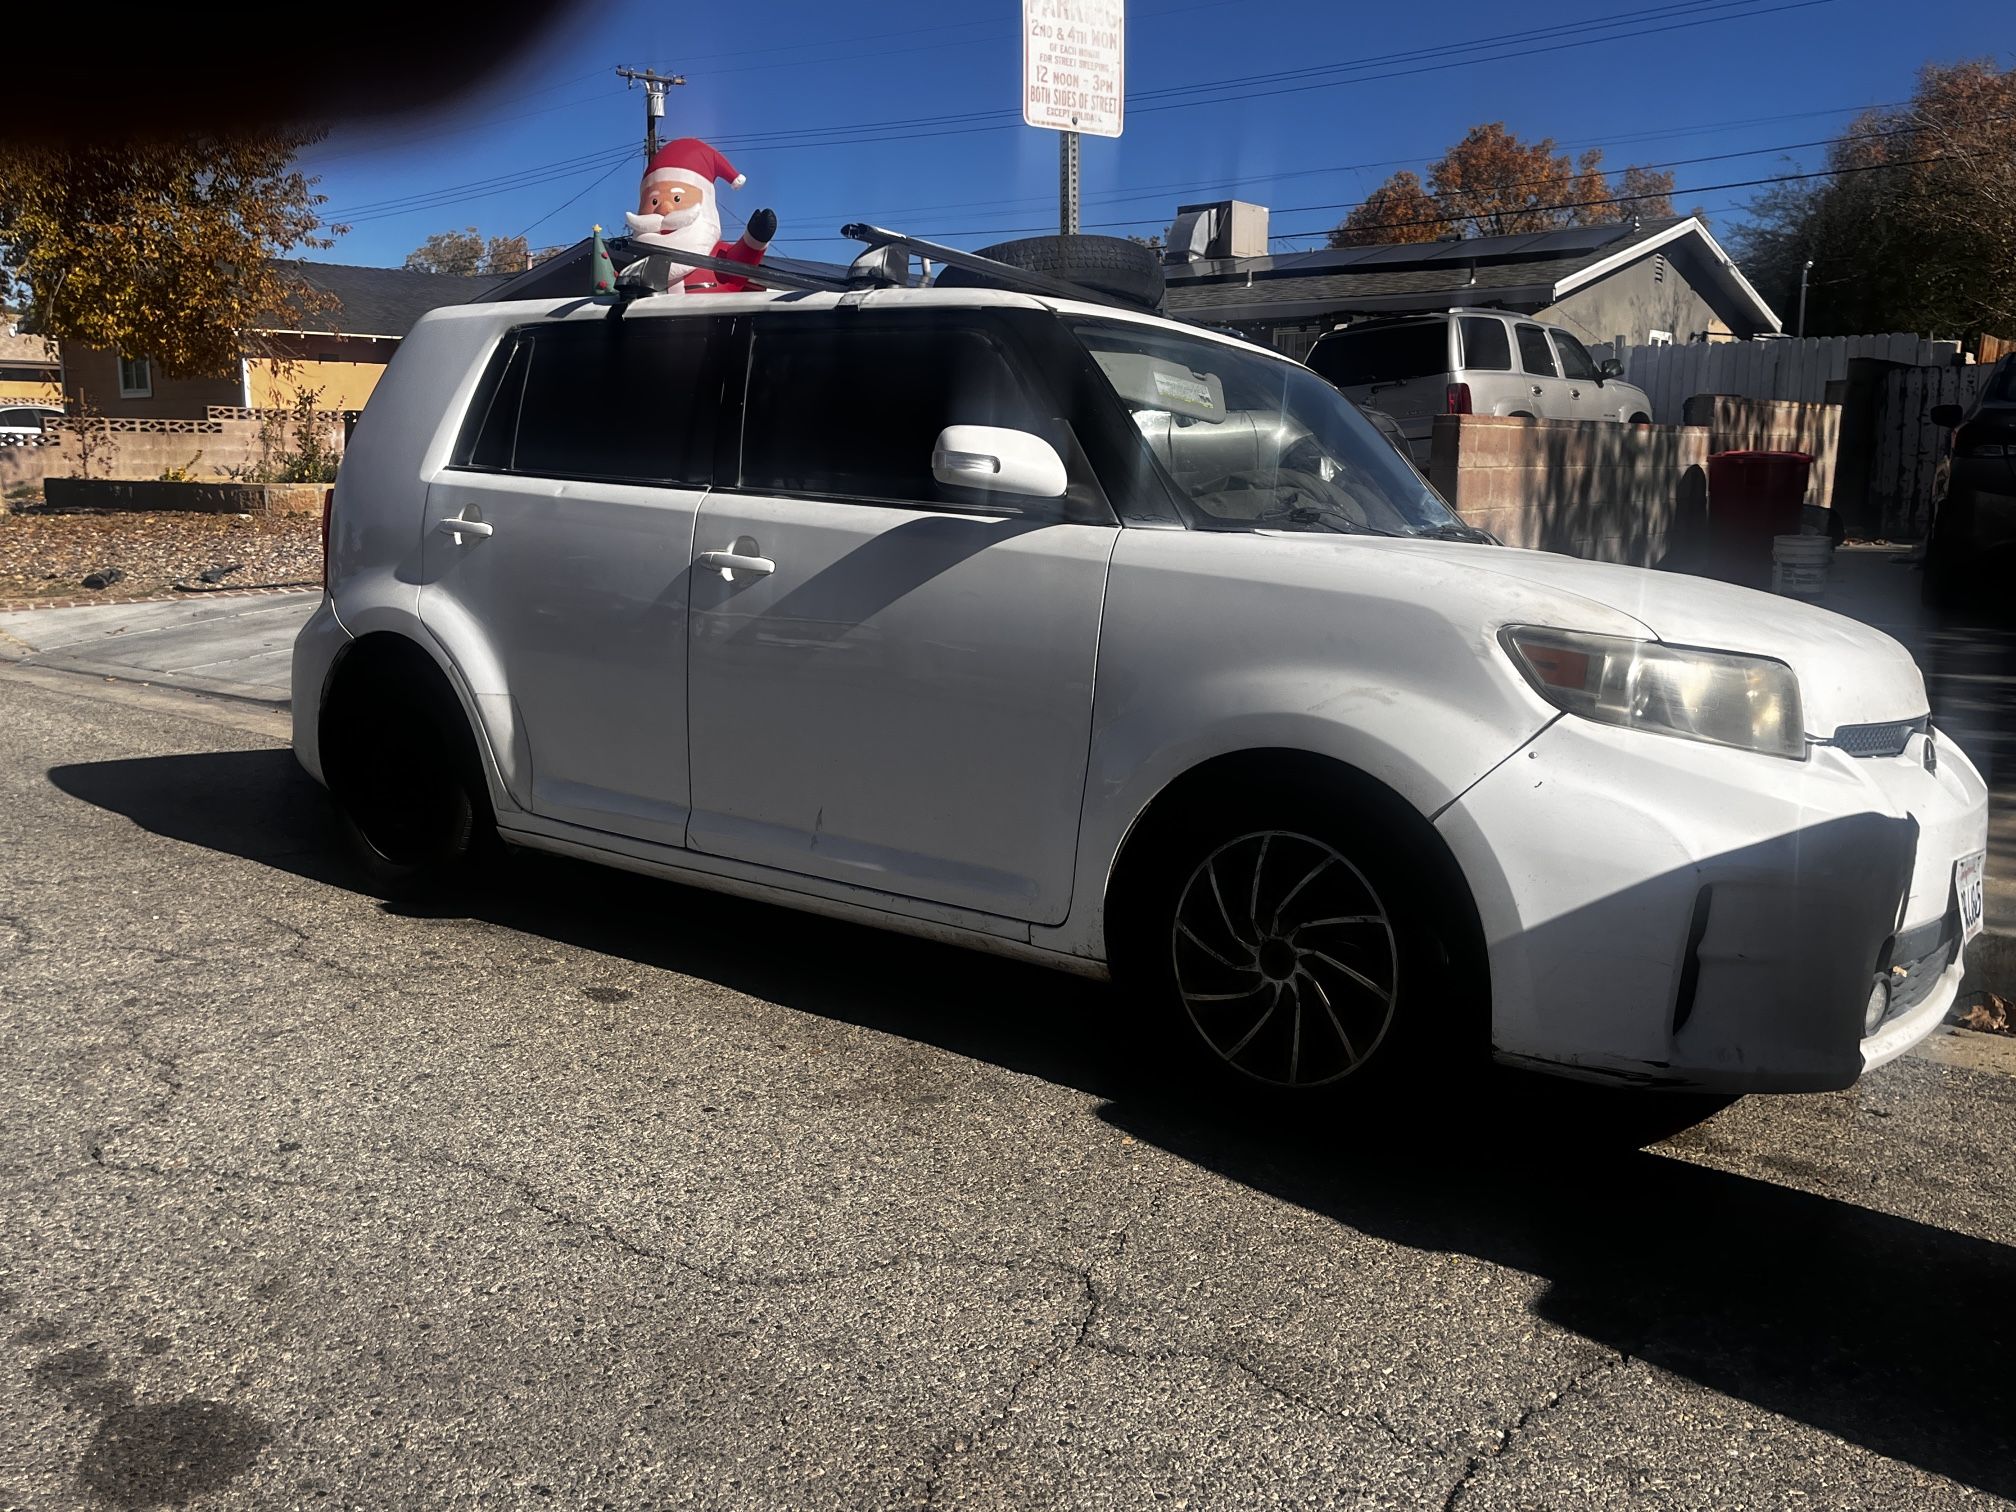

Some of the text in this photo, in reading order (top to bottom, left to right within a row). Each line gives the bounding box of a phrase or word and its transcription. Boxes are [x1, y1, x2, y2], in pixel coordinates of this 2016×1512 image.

[1030, 0, 1118, 29] ARKG
[1031, 19, 1117, 50] 2ND & 4TH MON
[1039, 53, 1052, 64] FOR
[1054, 55, 1077, 67] STREET
[1049, 43, 1057, 52] OF
[1060, 44, 1077, 56] EACH
[1036, 65, 1048, 83] 12
[1053, 72, 1079, 88] NOON
[1093, 74, 1113, 93] 3PM
[1030, 85, 1117, 114] BOTH SIDES OF STREET
[1046, 107, 1103, 123] EXCEPT HOLIDA
